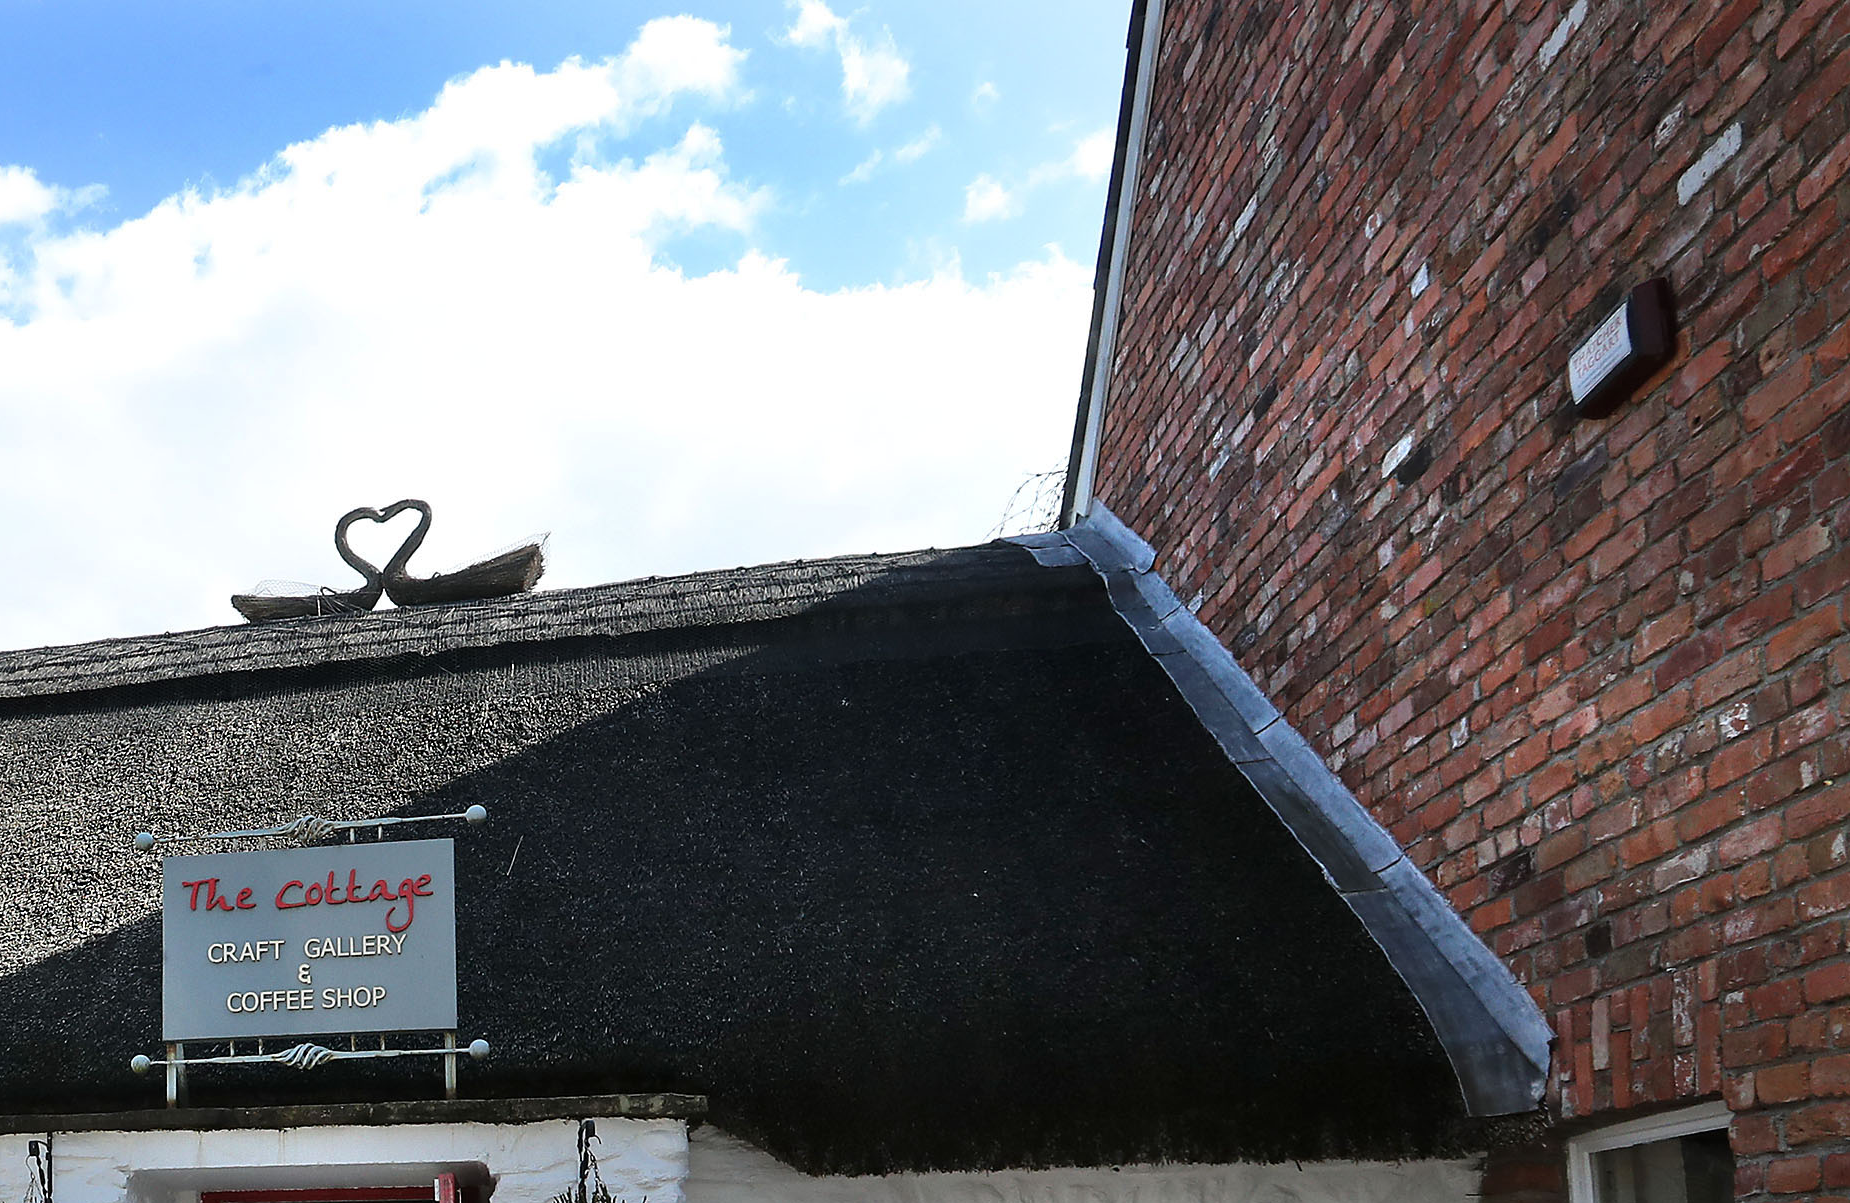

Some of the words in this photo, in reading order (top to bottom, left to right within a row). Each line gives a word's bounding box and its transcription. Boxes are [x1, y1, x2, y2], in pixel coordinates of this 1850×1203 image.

[181, 877, 257, 911] The
[274, 868, 434, 933] Cottage
[206, 940, 285, 963] CRAFT
[303, 934, 407, 960] GALLERY
[297, 964, 311, 984] &
[226, 989, 314, 1013] COFFEE
[321, 986, 387, 1009] SHOP
